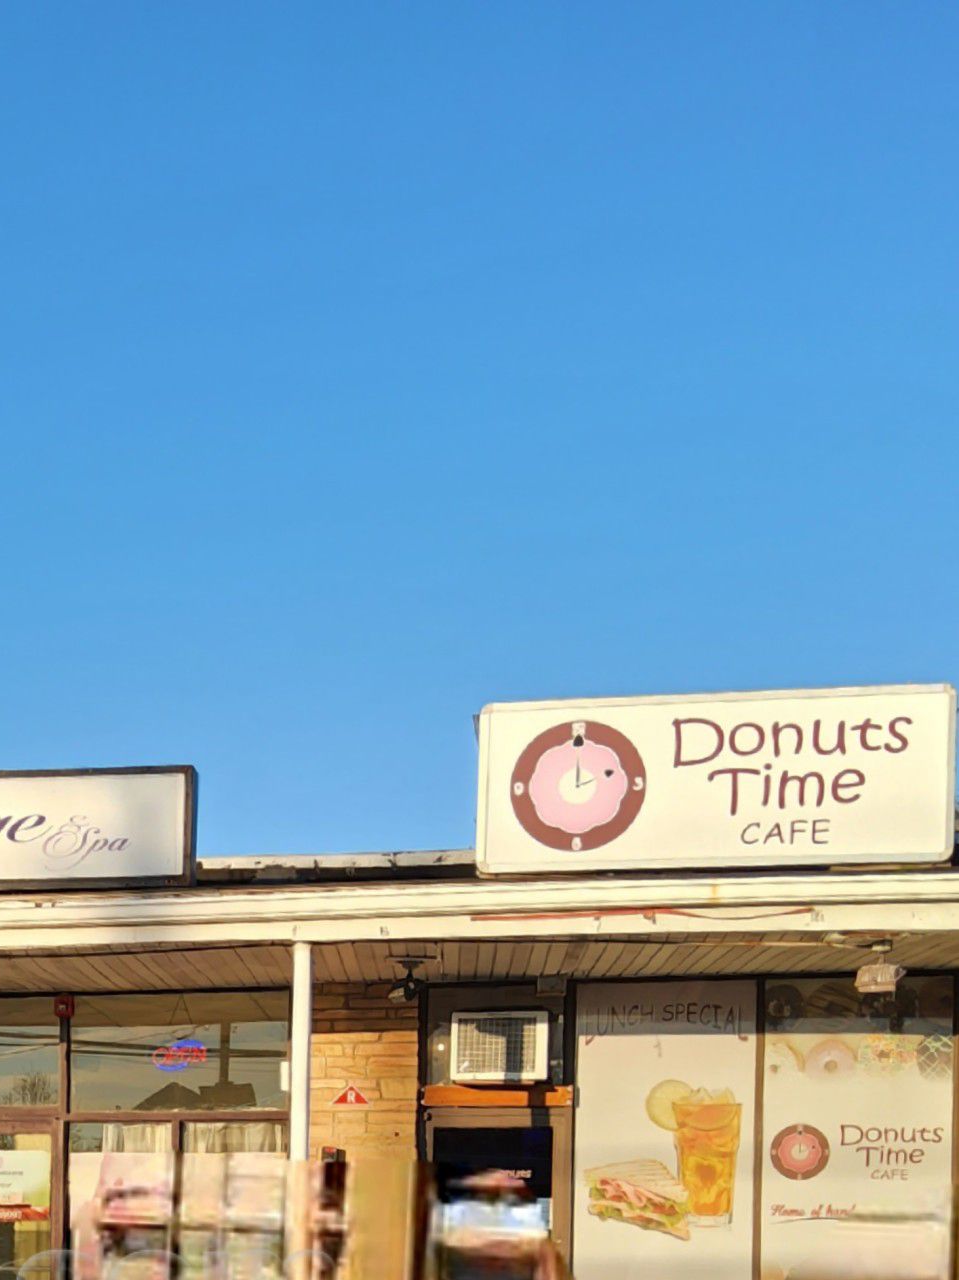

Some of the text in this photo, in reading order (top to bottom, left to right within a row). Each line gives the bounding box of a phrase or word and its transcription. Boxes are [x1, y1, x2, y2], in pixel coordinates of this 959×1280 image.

[672, 716, 913, 768] Donuts
[707, 763, 866, 816] Time
[740, 819, 831, 845] CAFE
[42, 825, 129, 871] Spa
[661, 1002, 748, 1042] SPECIAL
[840, 1124, 945, 1146] Donuts
[855, 1145, 925, 1168] Time
[870, 1168, 909, 1181] CAFE
[811, 1203, 824, 1218] of
